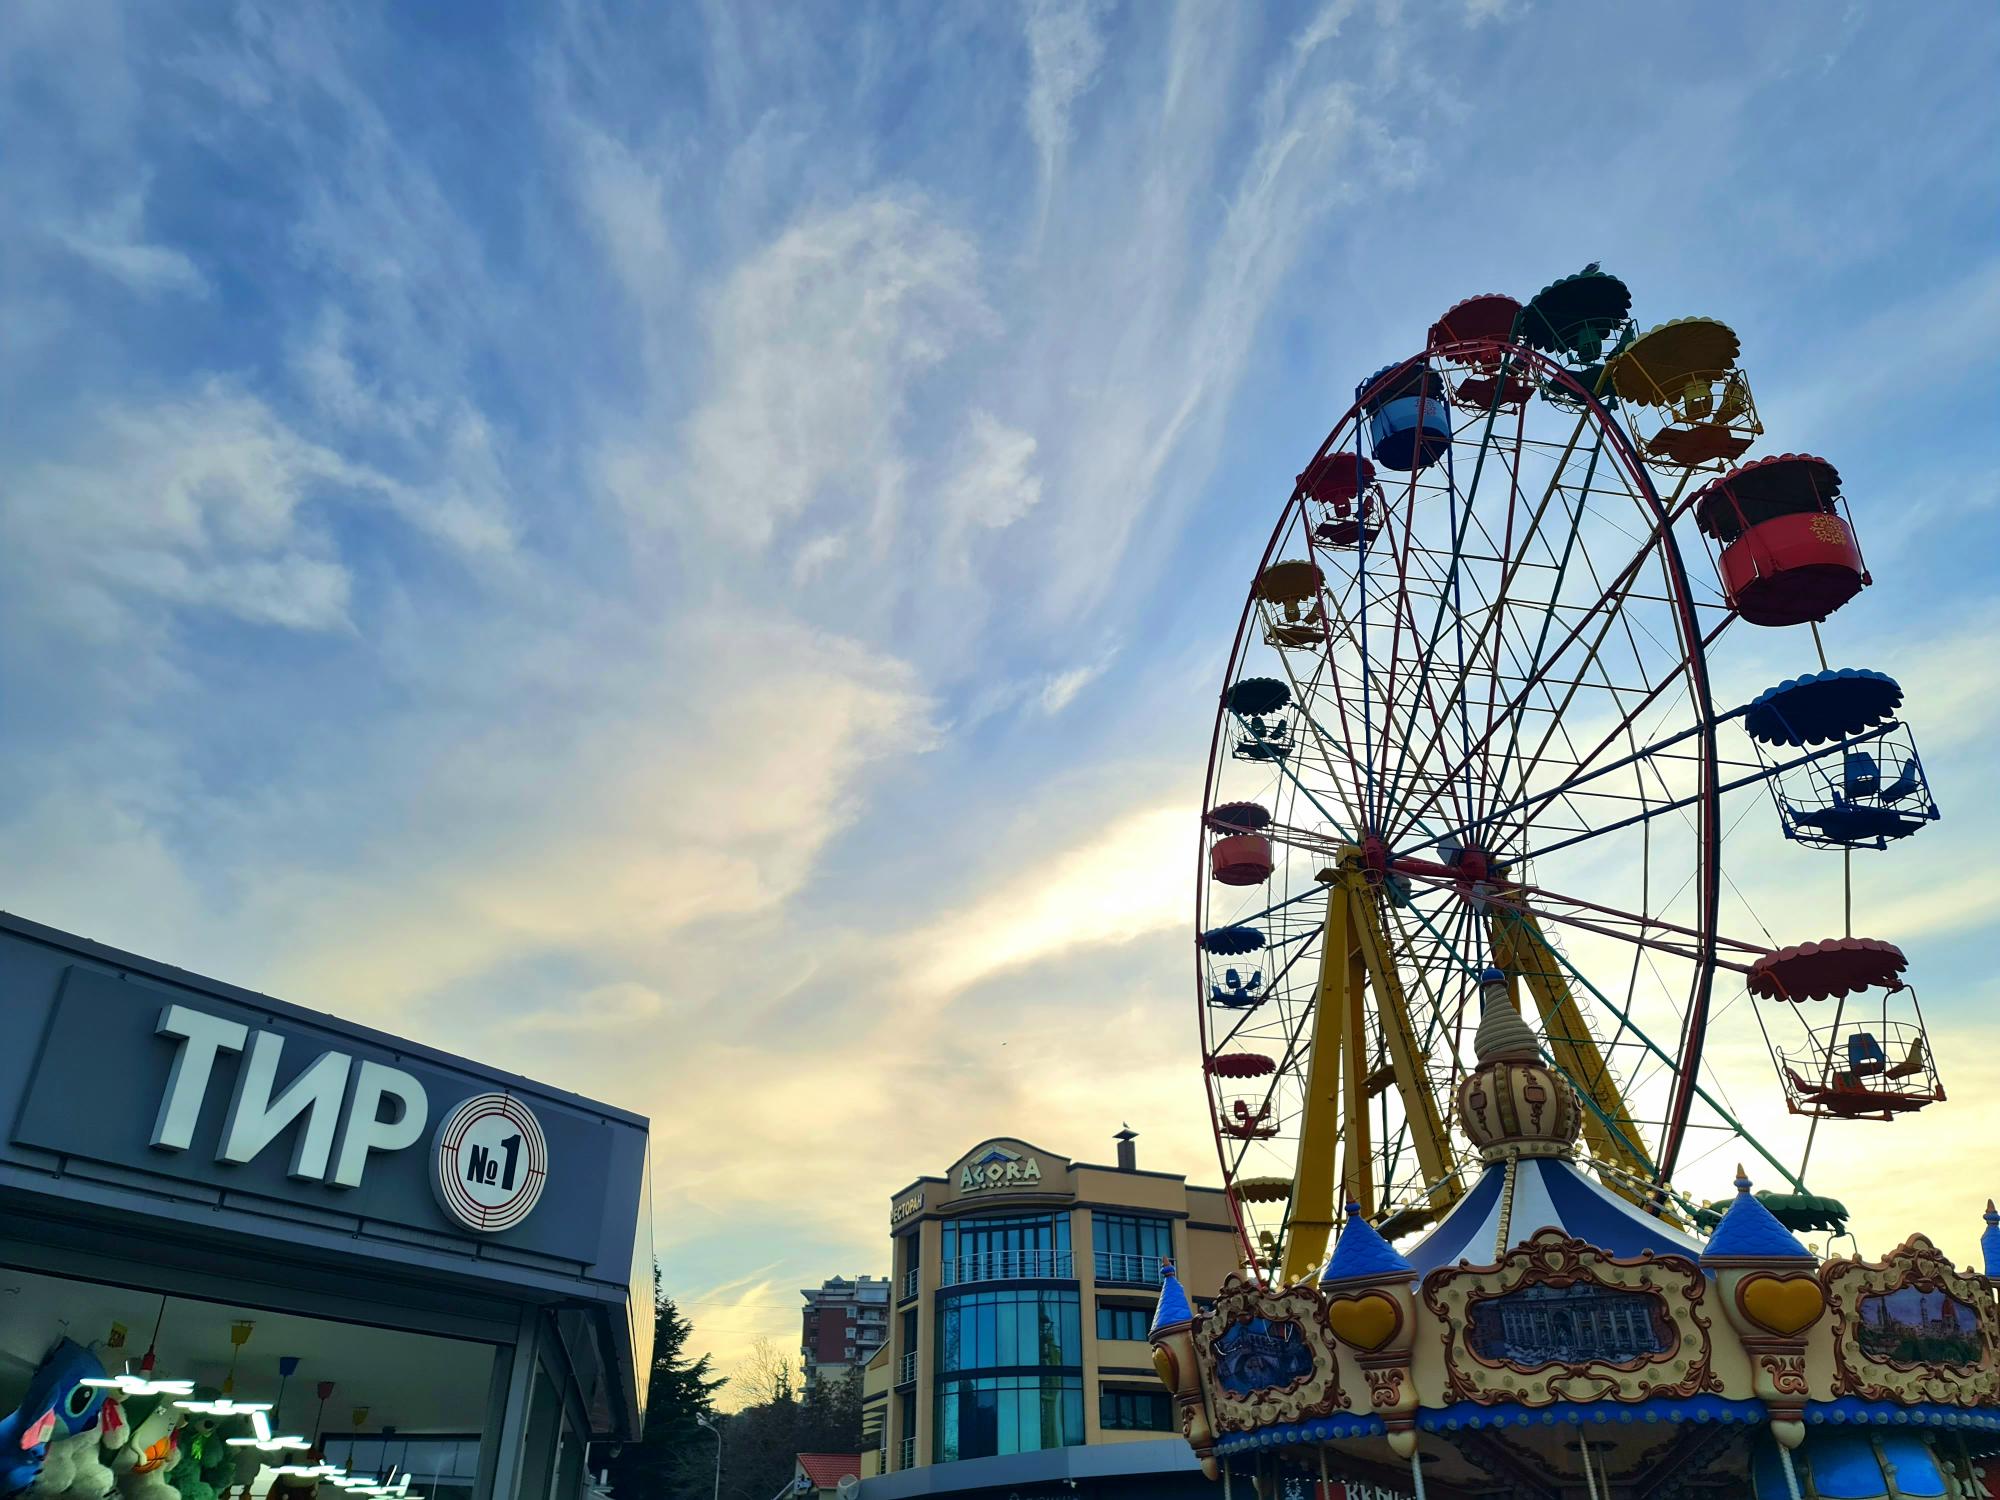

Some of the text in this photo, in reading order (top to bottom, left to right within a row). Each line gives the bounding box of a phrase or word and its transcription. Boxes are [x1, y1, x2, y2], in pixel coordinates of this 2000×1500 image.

[151, 1004, 521, 1191] ТИР №1
[960, 1157, 1041, 1188] AGORA
